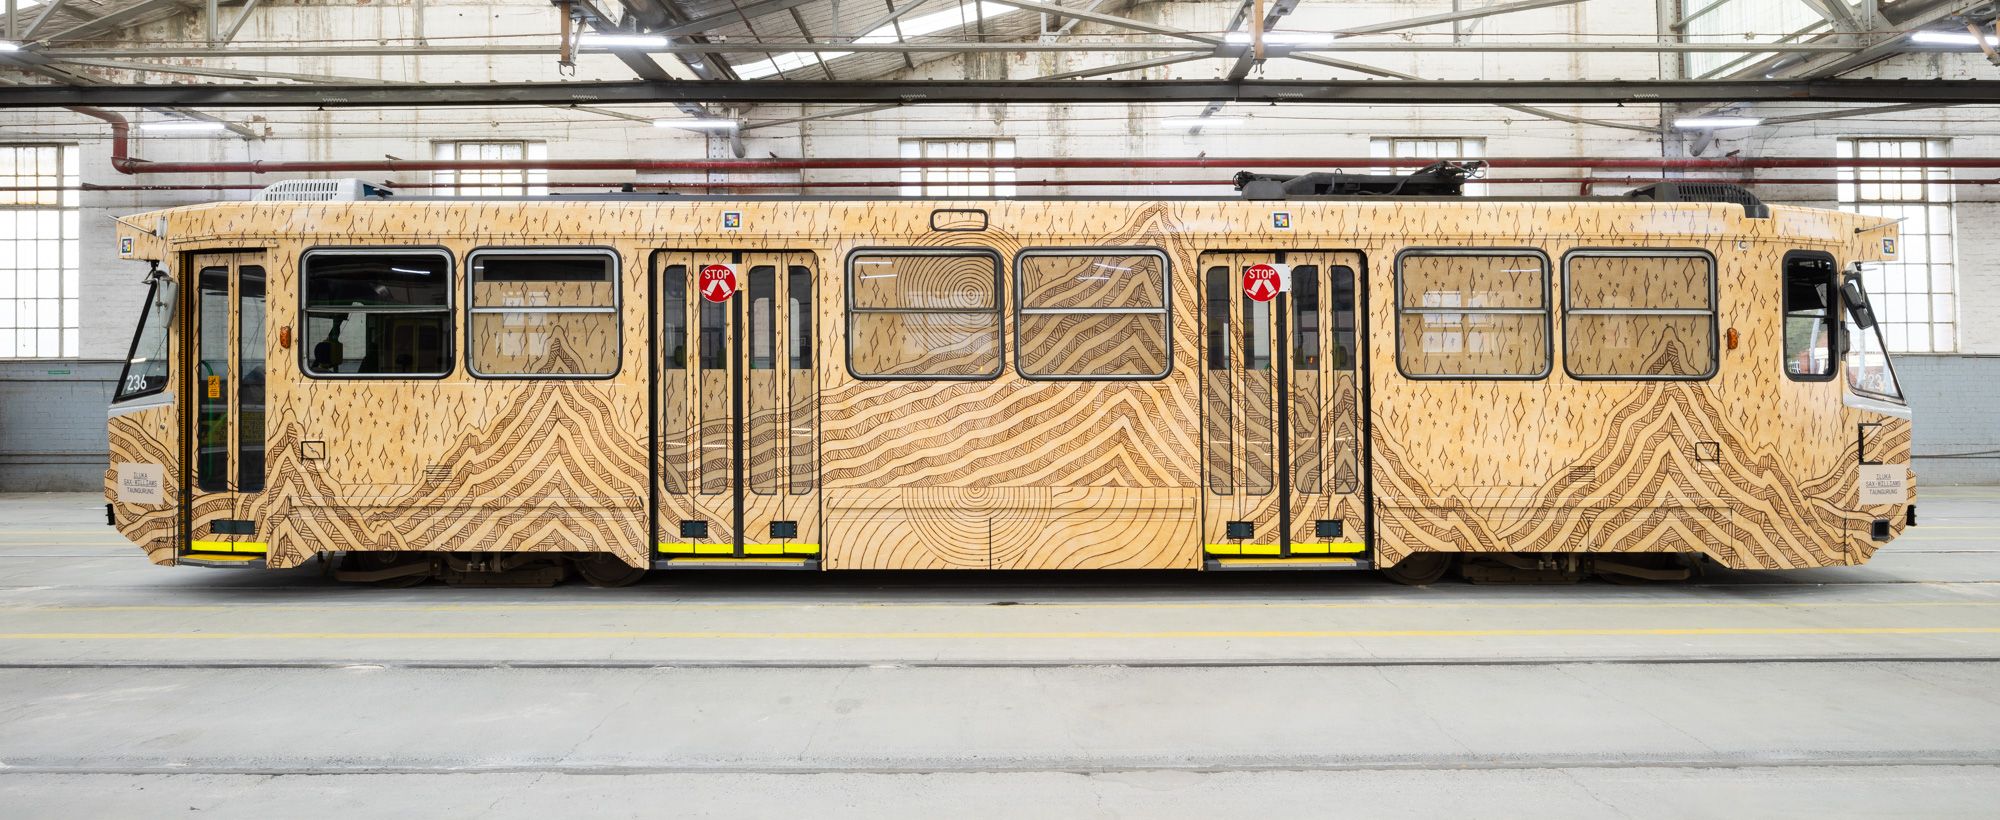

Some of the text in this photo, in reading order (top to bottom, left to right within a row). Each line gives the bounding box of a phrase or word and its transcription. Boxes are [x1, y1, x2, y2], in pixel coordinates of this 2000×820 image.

[704, 269, 730, 280] STOP
[1248, 268, 1275, 279] STOP
[127, 374, 147, 390] 236
